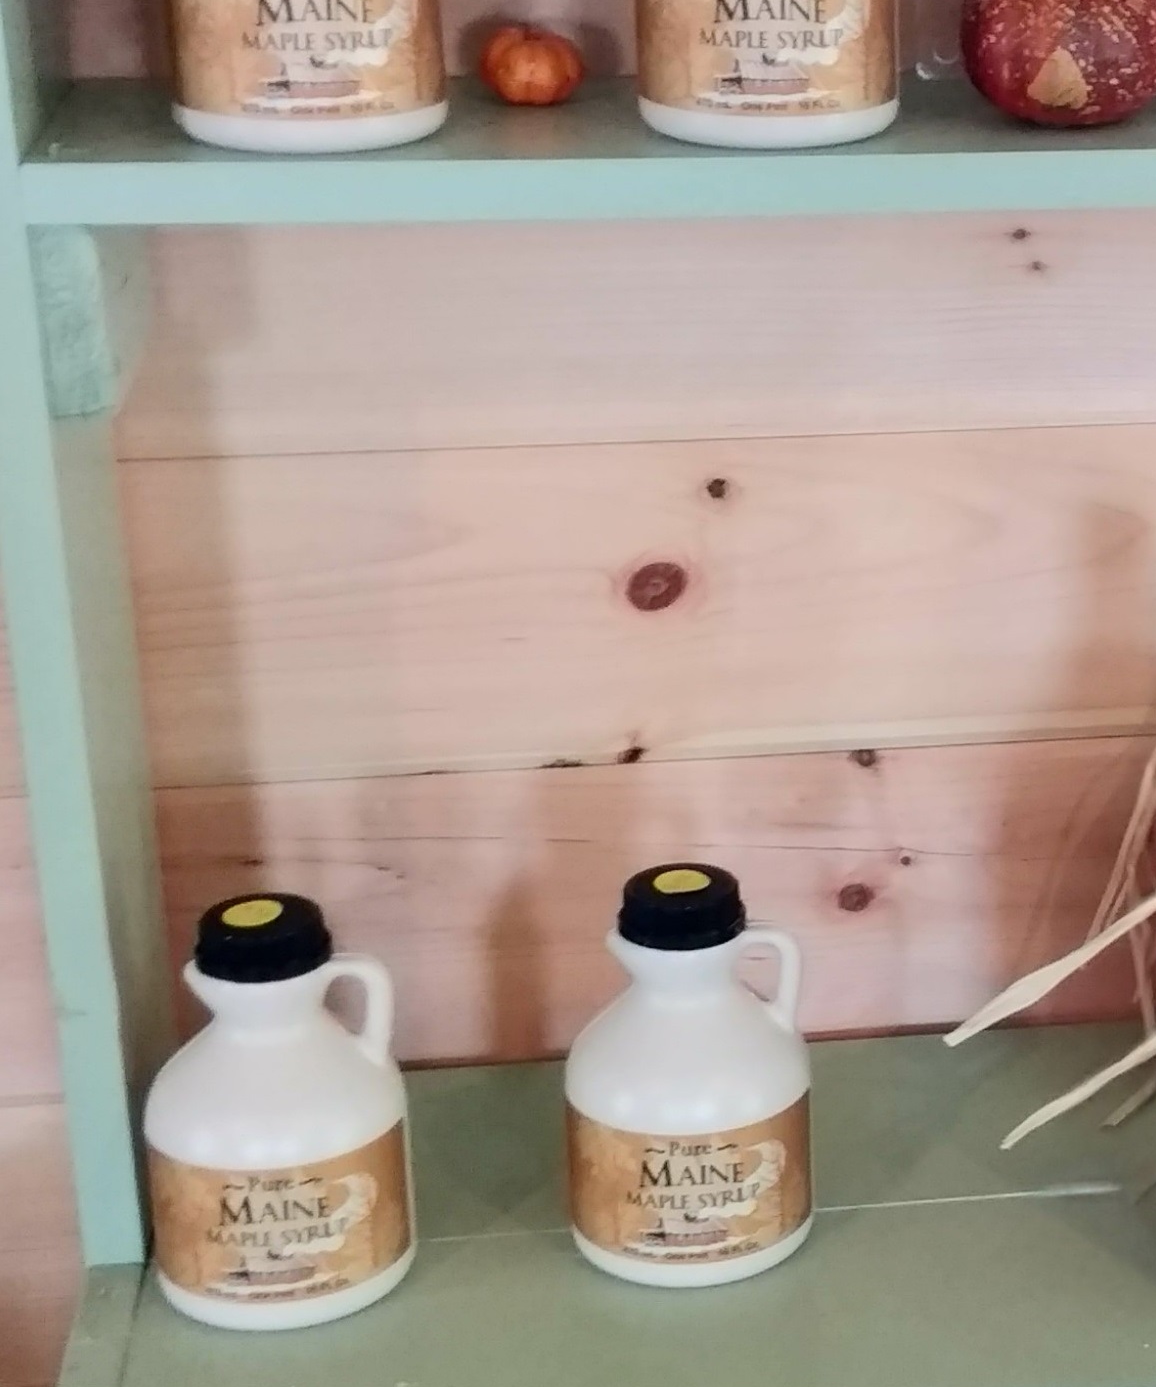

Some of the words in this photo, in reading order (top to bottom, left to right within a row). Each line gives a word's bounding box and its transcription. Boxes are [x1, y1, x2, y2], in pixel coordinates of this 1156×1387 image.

[242, 32, 318, 51] MAPLE
[323, 29, 393, 51] SYRUP
[700, 29, 769, 48] MAPLE
[778, 28, 845, 48] SYRUP
[672, 1141, 712, 1157] Pure
[639, 1160, 745, 1188] MAINE
[626, 1191, 690, 1210] MAPLE
[698, 1182, 760, 1209] SYRUP
[220, 1196, 331, 1226] MAINE
